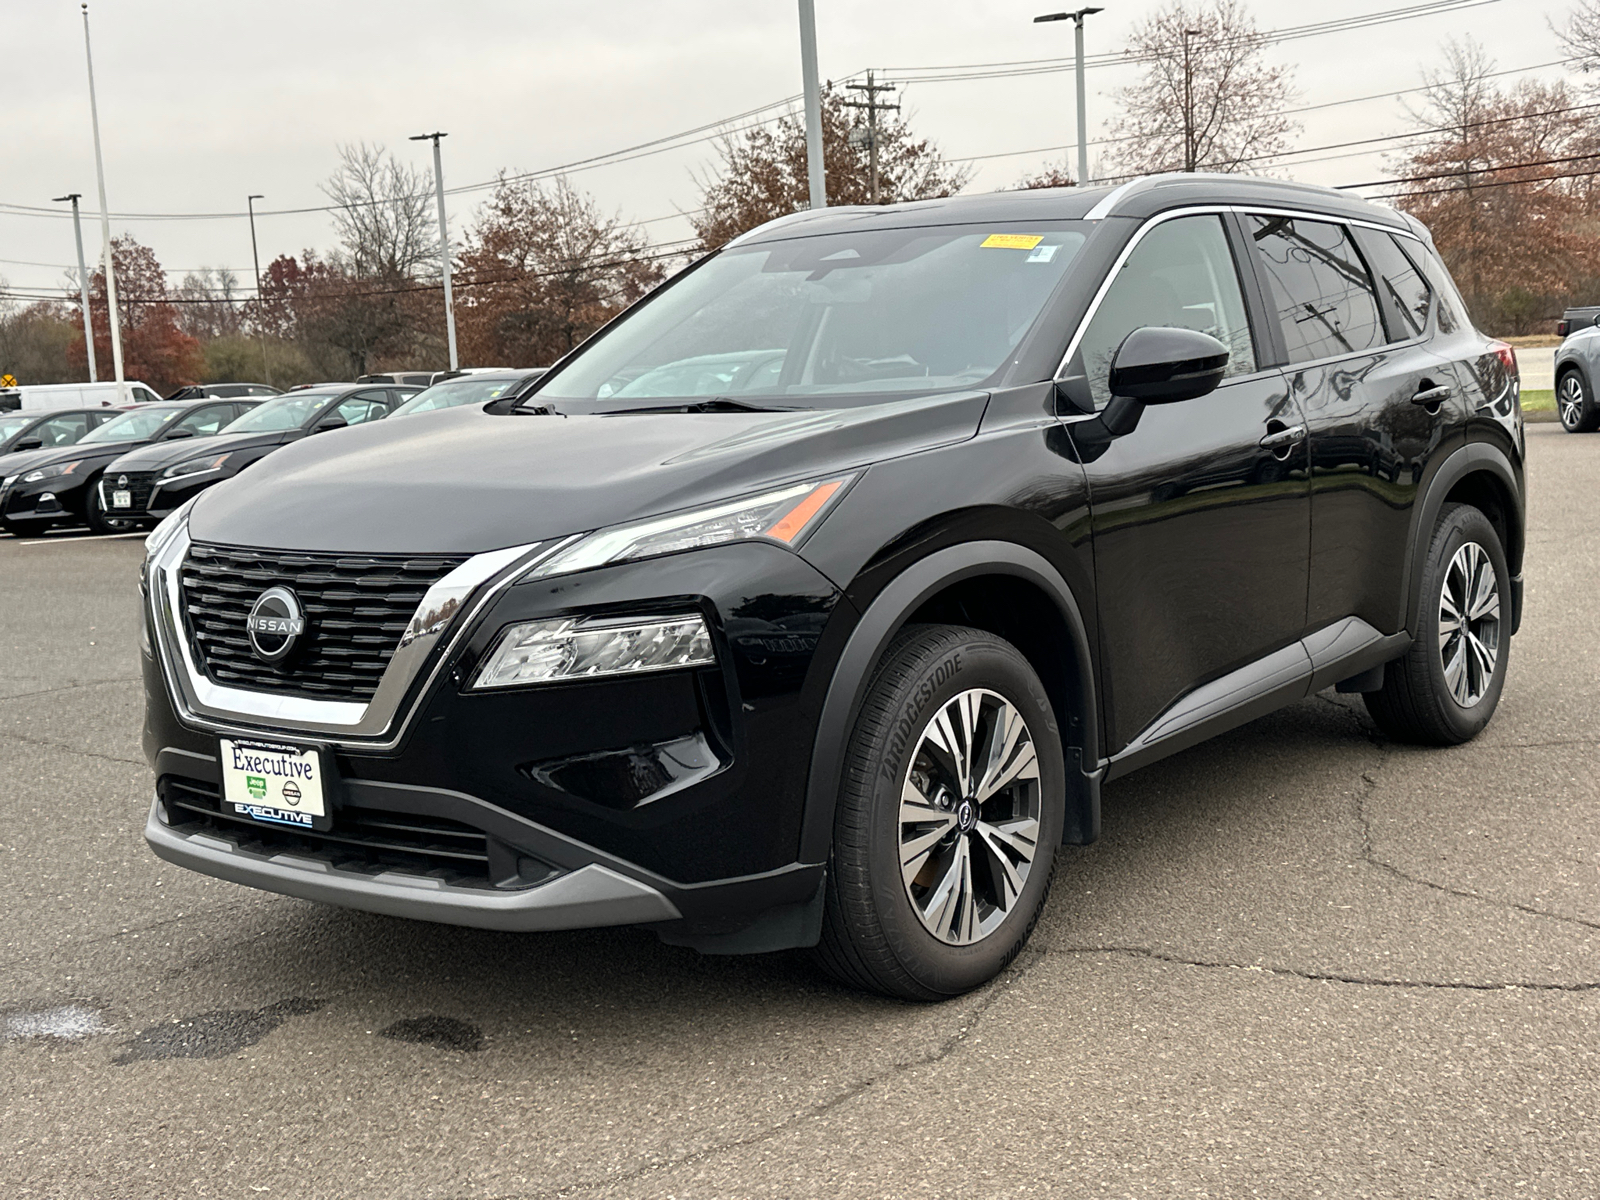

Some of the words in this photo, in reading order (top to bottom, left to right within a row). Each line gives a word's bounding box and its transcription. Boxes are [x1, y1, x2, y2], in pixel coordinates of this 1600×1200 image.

[247, 617, 301, 633] NISSAN
[881, 653, 963, 785] BRIDGESTONE
[232, 746, 313, 780] Executive
[249, 777, 264, 788] Jeep
[234, 803, 313, 825] EXECUTIVE
